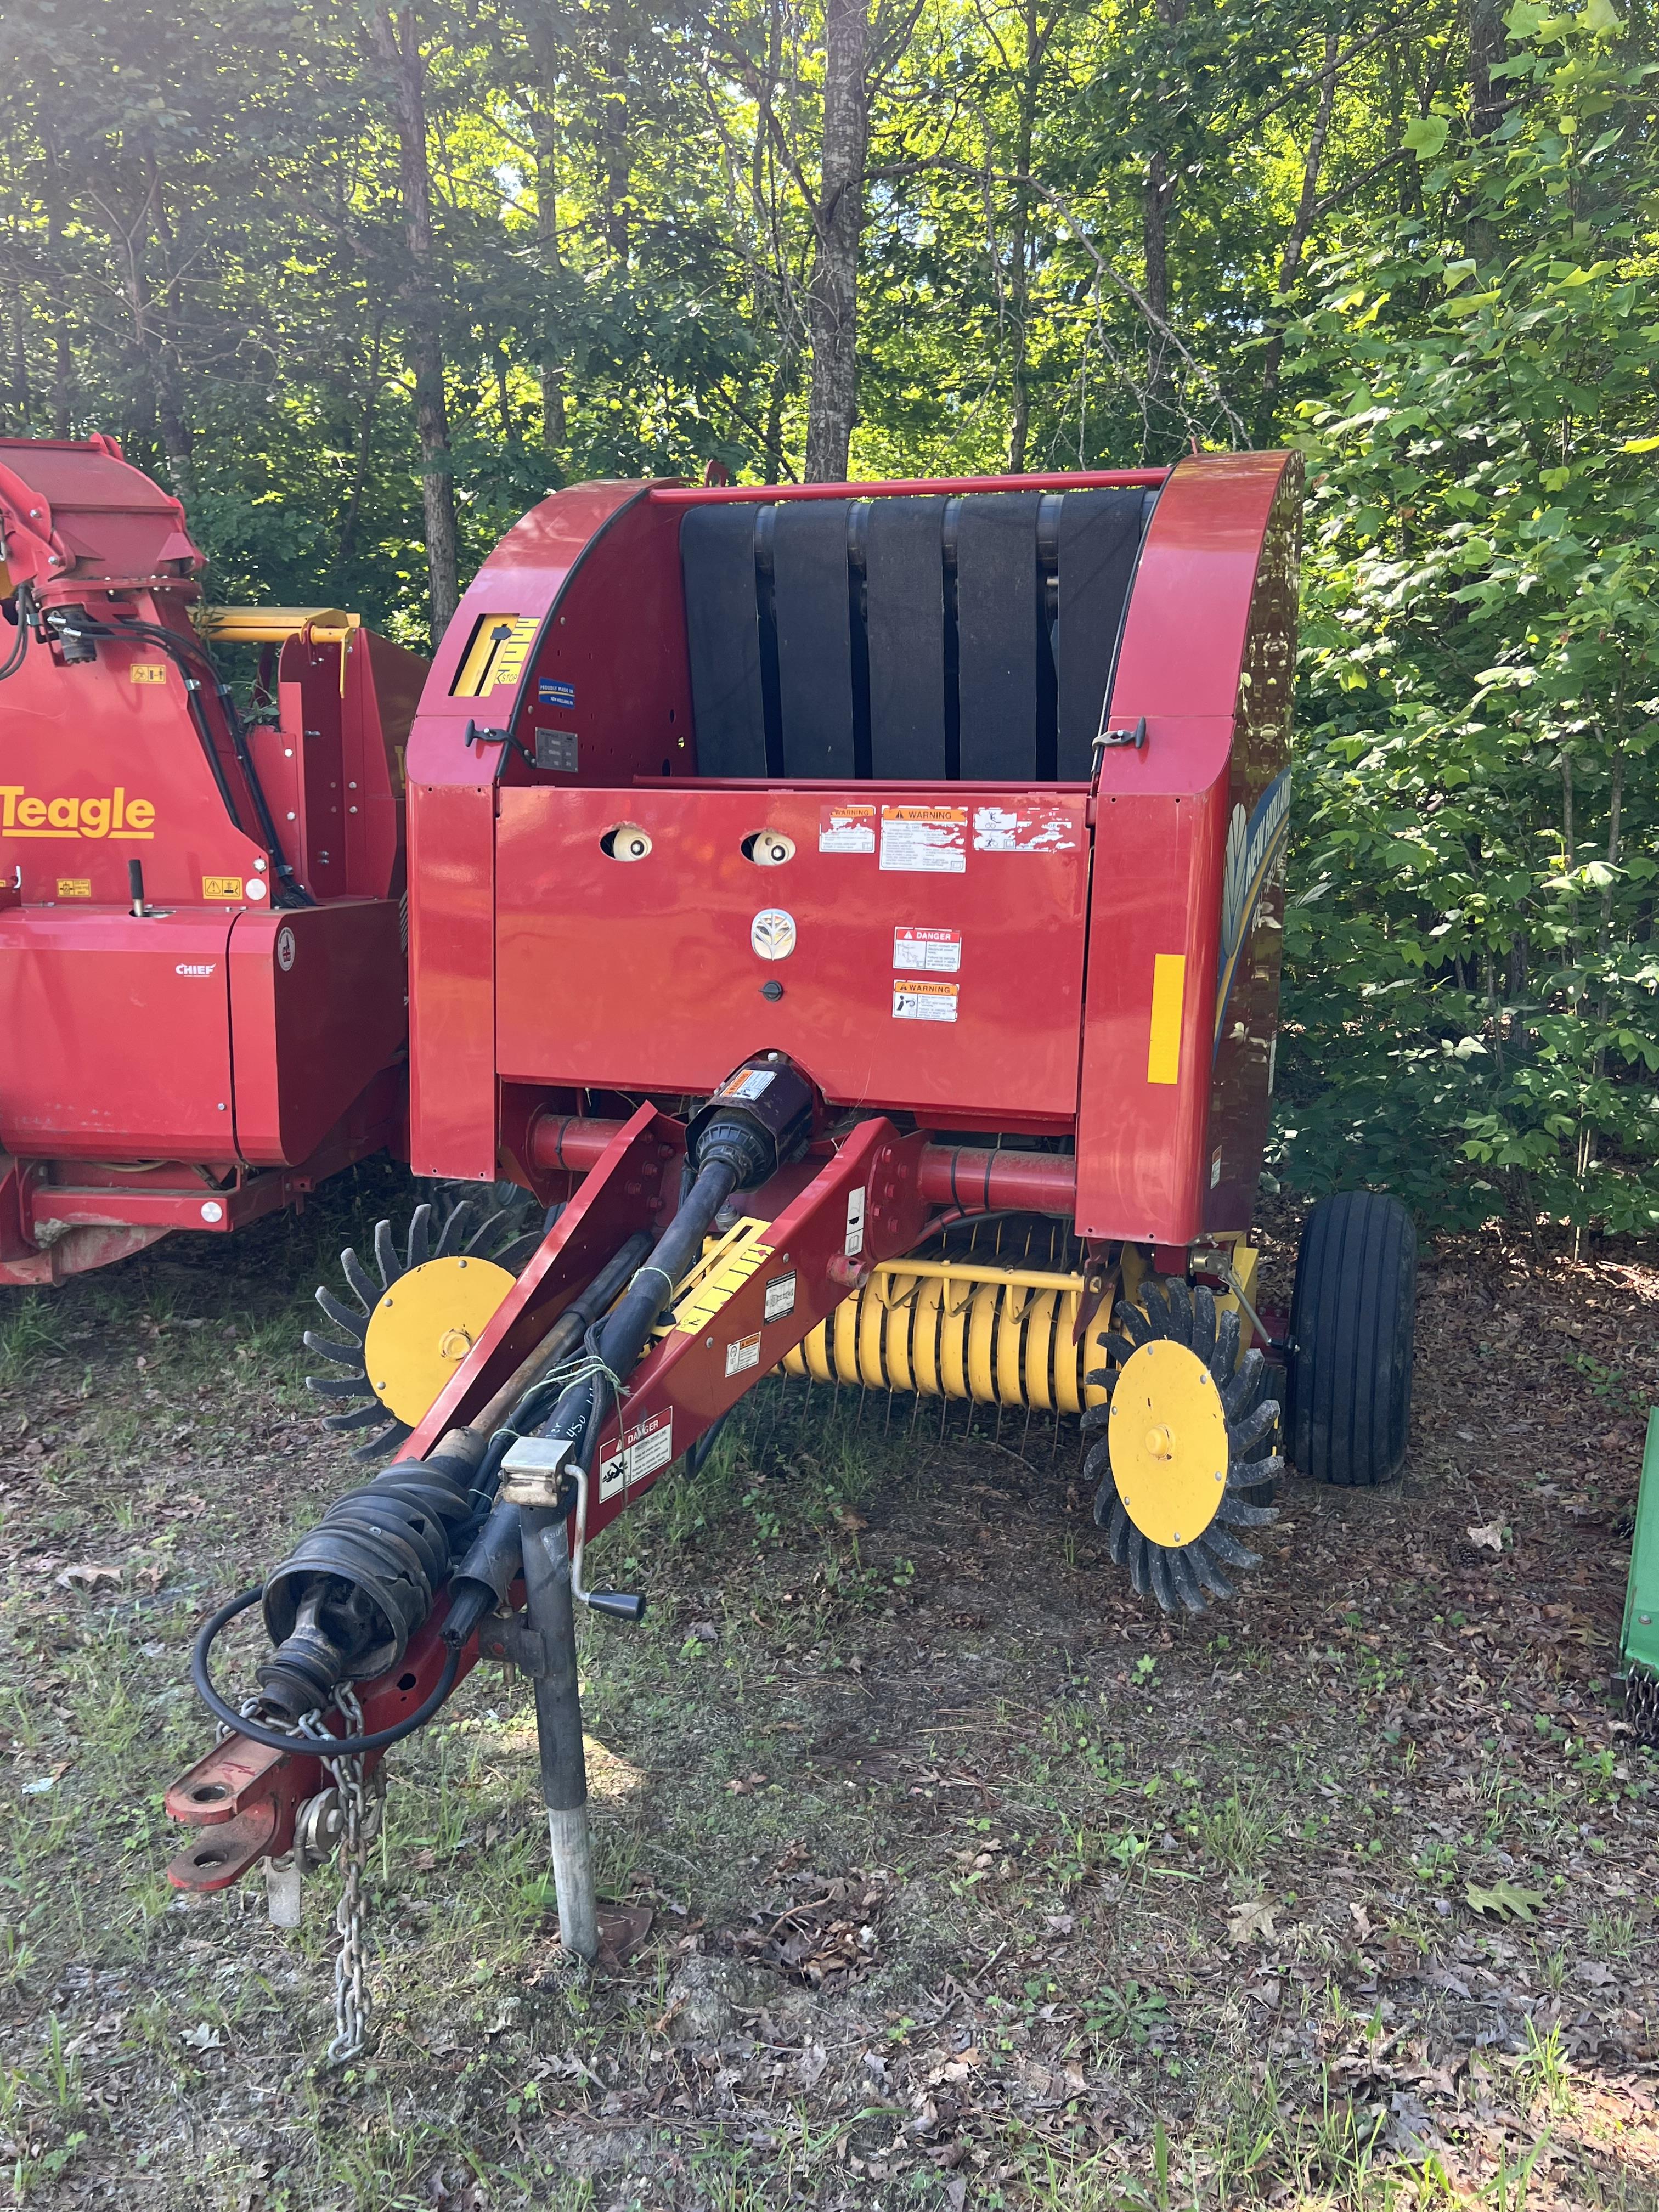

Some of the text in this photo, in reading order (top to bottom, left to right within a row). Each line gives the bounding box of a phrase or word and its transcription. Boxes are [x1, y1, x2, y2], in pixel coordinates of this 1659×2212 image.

[501, 674, 518, 682] STOP
[0, 785, 156, 839] Teagle
[909, 811, 952, 820] WARNING
[916, 931, 951, 941] DANGER
[176, 963, 216, 975] CHIEF
[909, 984, 951, 994] WARNING
[566, 1415, 586, 1437] 450
